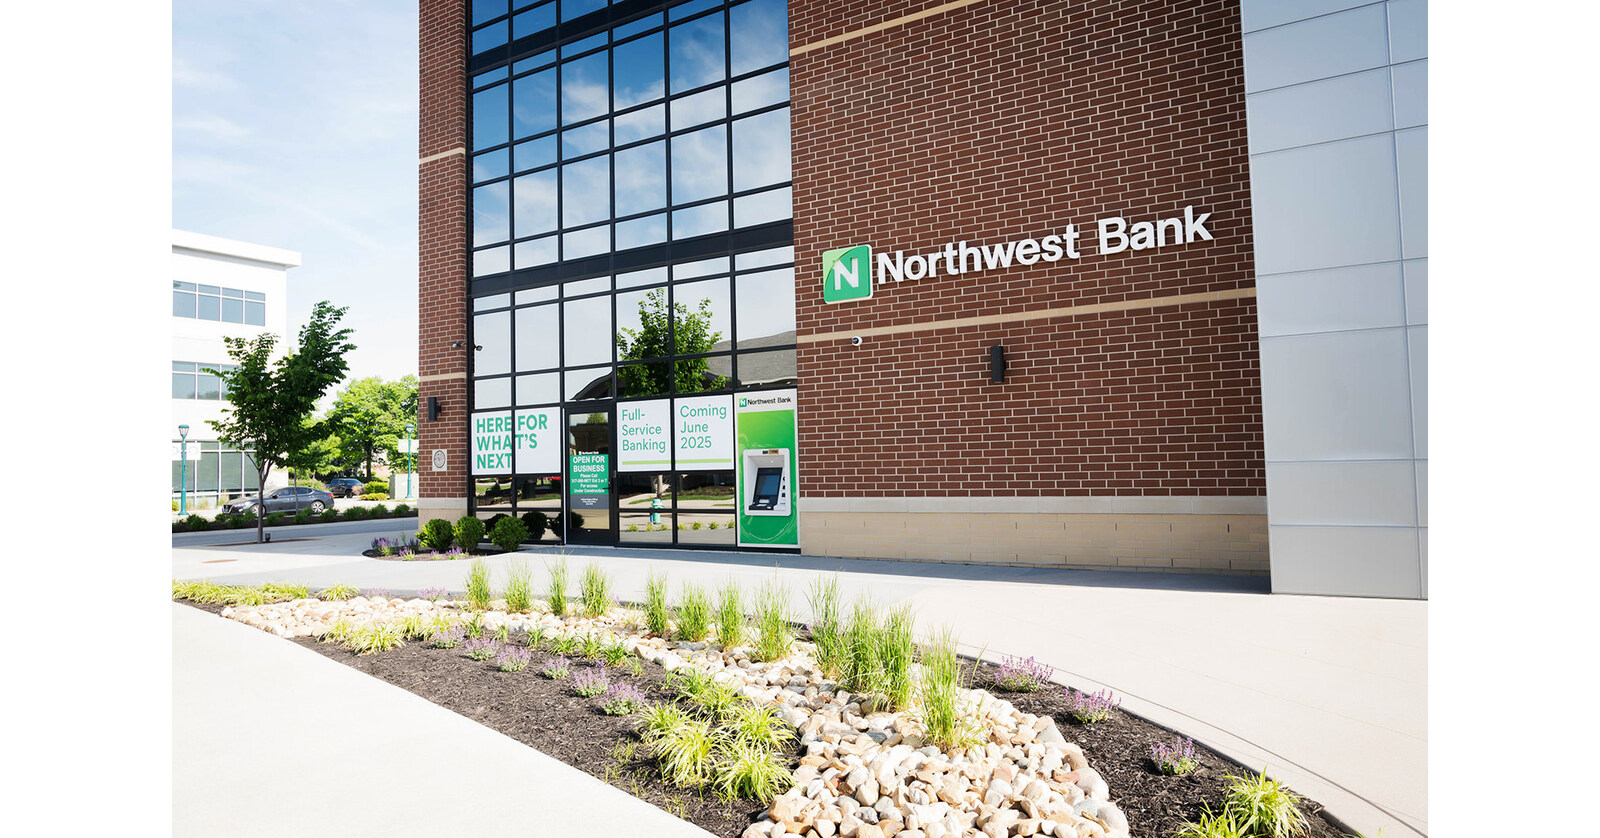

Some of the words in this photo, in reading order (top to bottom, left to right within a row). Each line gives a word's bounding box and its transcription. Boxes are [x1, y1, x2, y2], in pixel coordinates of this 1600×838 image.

[832, 257, 859, 291] N
[877, 223, 1080, 285] Northwest
[1098, 205, 1214, 255] Bank
[621, 408, 646, 421] Full-
[680, 404, 727, 420] Coming
[476, 416, 512, 433] HERE
[517, 414, 548, 431] FOR
[621, 423, 662, 436] Service
[680, 421, 709, 433] June
[476, 433, 538, 451] WHAT'S
[622, 438, 666, 453] Banking
[680, 436, 712, 449] 2025
[476, 453, 512, 469] NEXT
